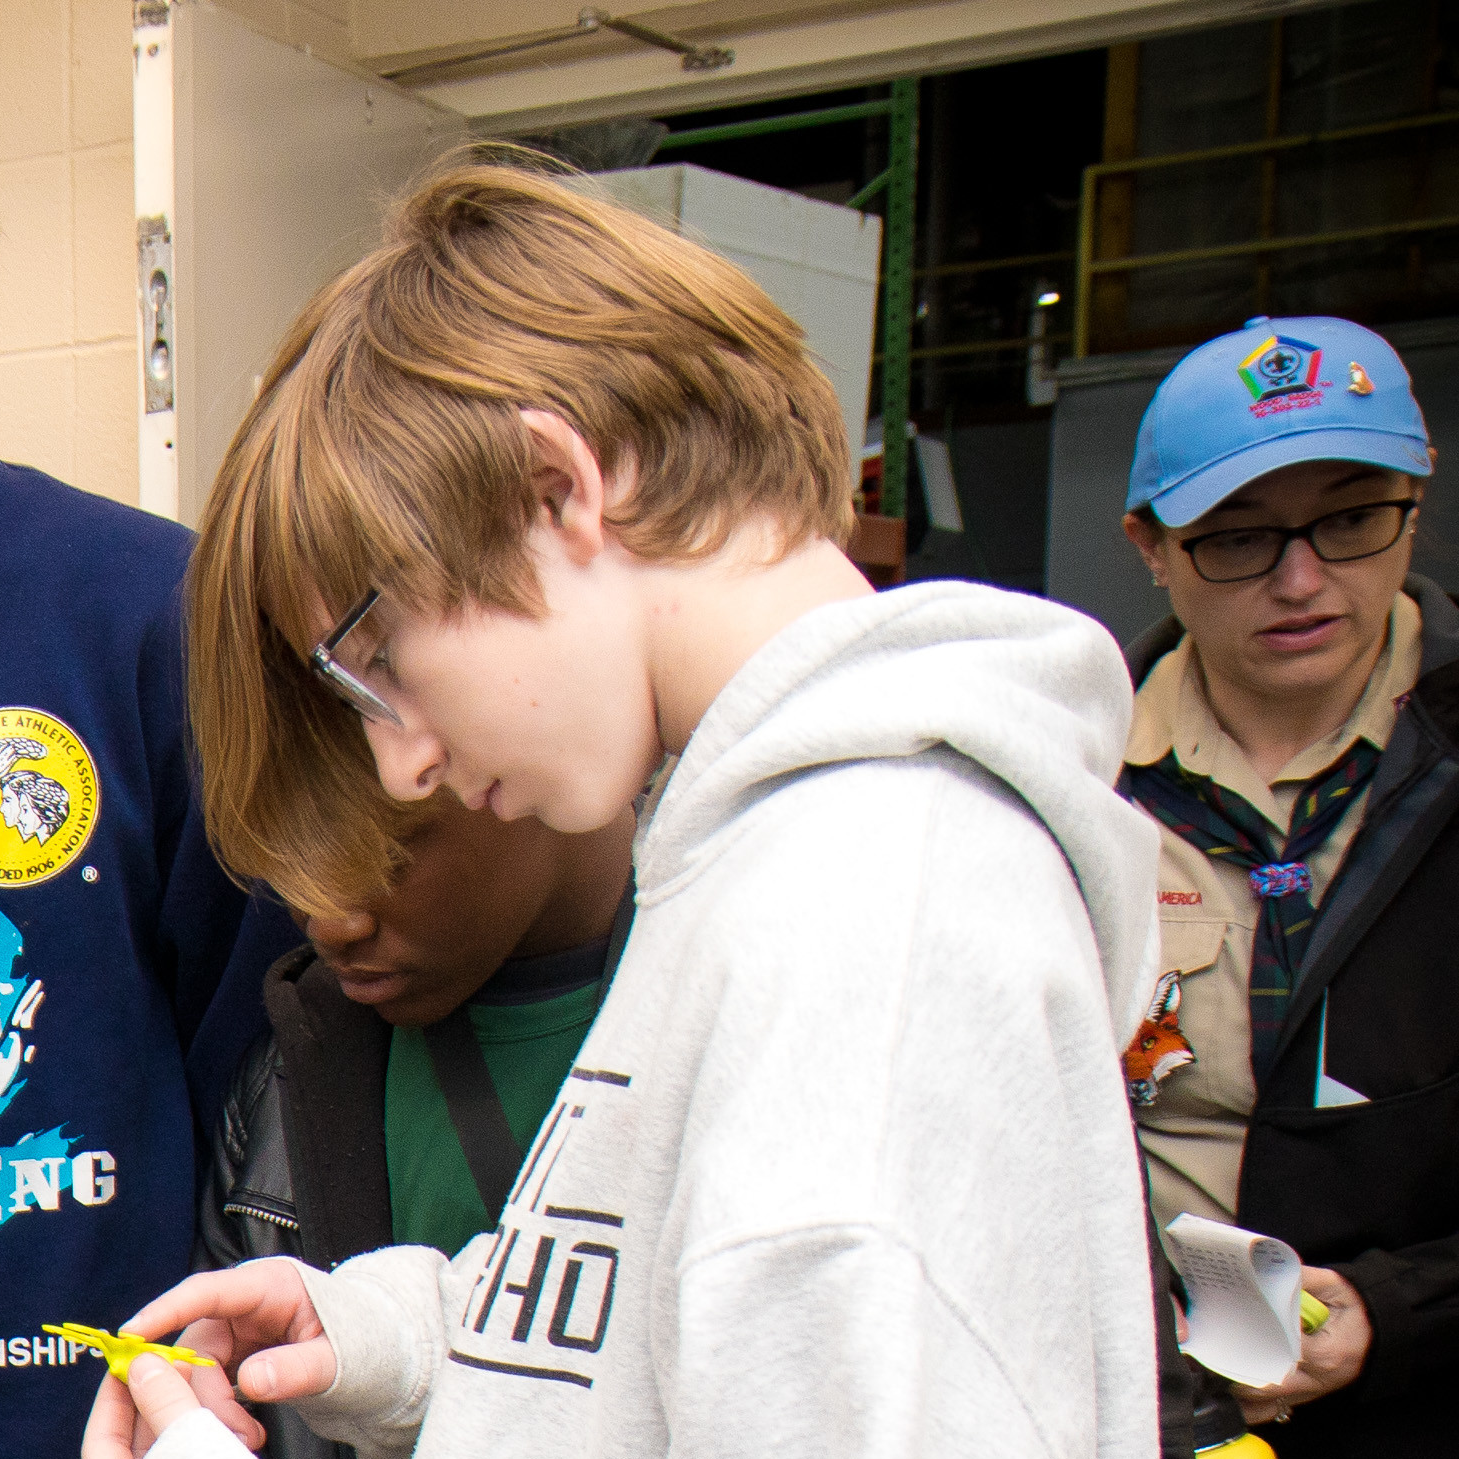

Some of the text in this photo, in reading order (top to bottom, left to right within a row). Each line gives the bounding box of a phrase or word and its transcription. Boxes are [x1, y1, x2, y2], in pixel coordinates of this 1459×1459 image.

[14, 715, 77, 756] ATHLETIC
[61, 758, 93, 856] ASSOCIATION
[26, 859, 56, 879] 1906
